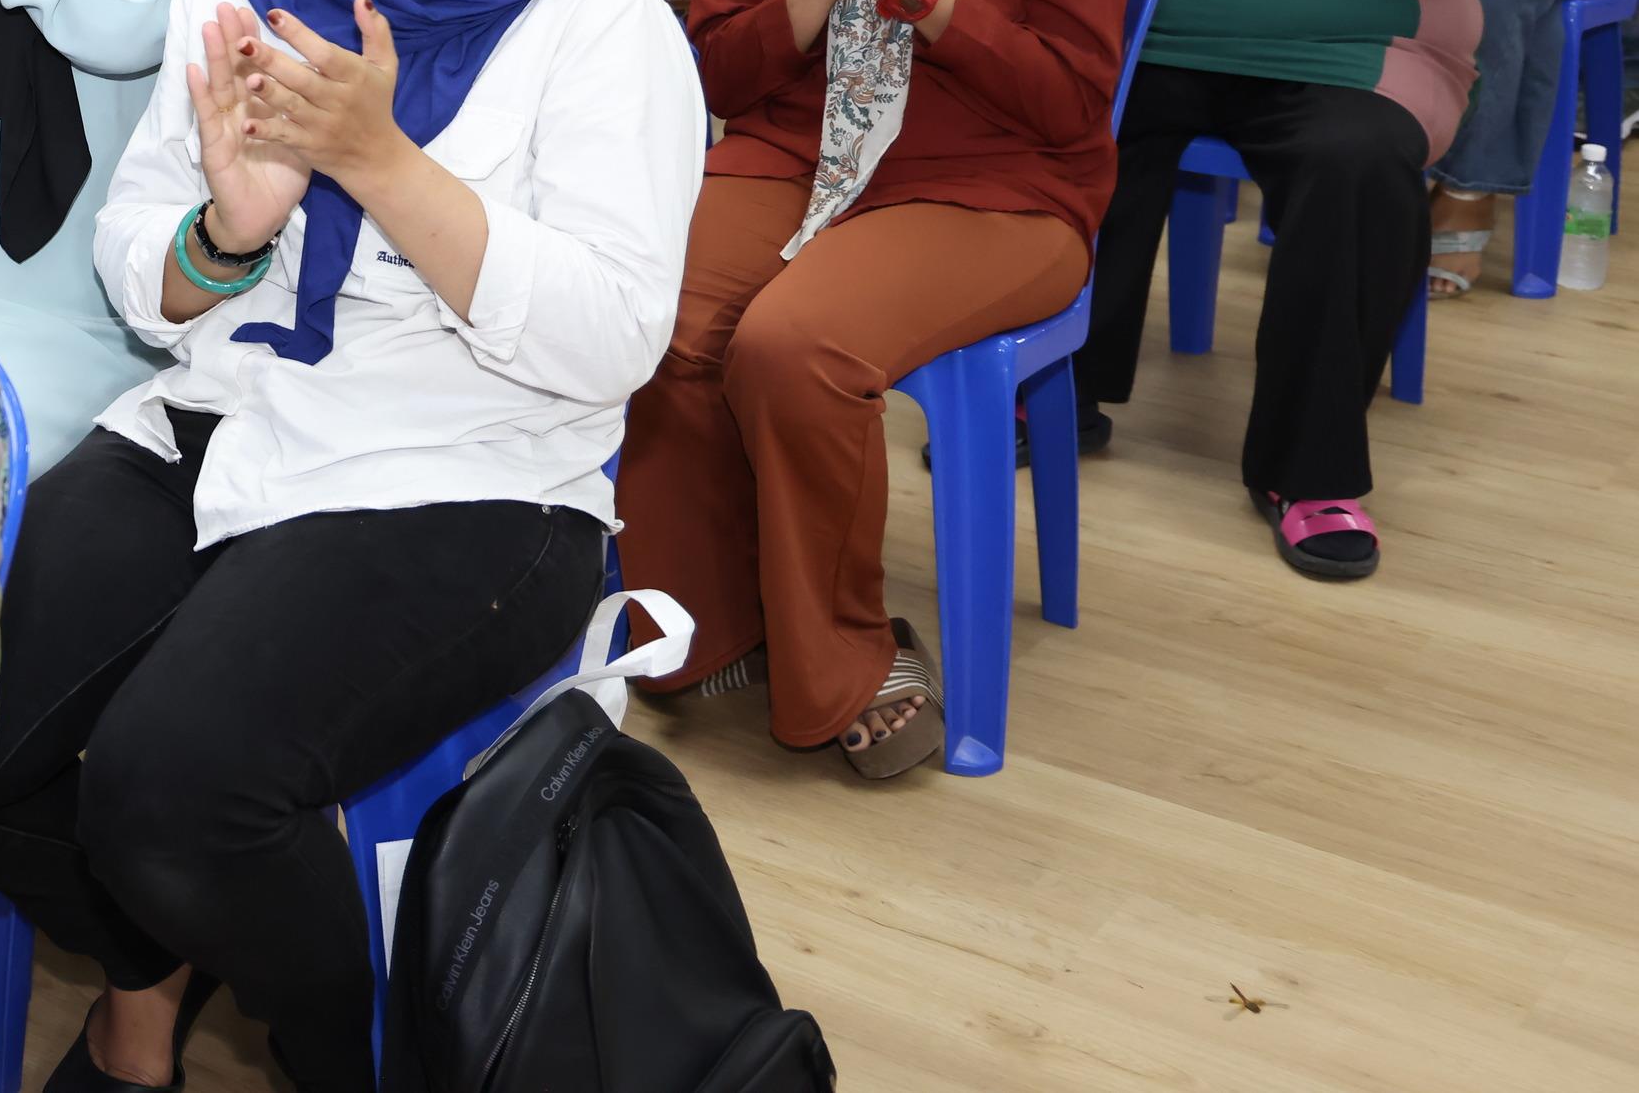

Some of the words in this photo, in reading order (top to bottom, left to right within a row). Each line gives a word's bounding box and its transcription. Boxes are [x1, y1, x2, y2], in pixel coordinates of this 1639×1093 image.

[541, 764, 574, 801] Calvin
[564, 740, 591, 767] Klein
[436, 963, 463, 1011] Calvin
[452, 926, 478, 963] Klein
[470, 879, 499, 926] Jeans
